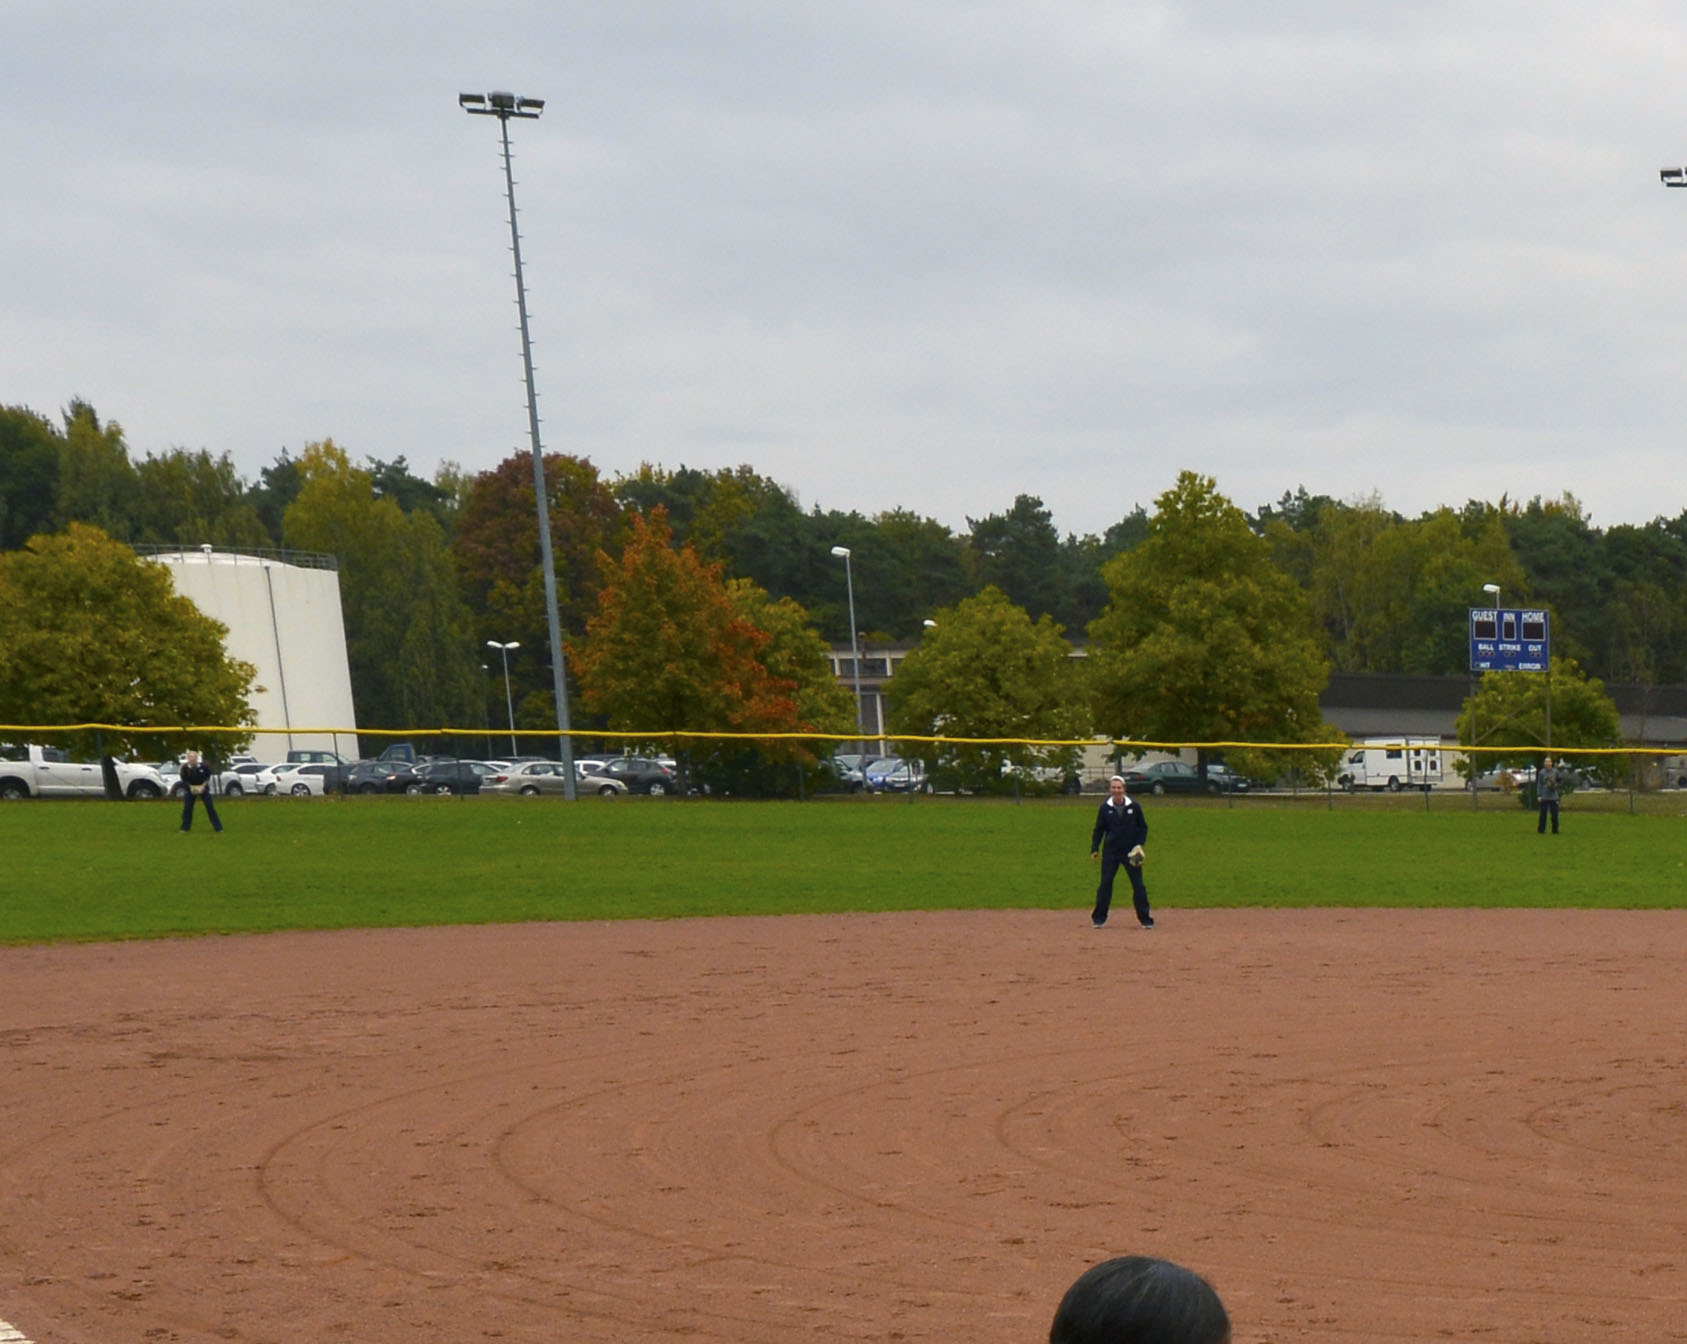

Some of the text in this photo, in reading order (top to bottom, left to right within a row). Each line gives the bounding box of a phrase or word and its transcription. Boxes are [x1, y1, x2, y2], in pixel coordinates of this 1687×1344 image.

[1472, 610, 1544, 622] GUEST INN HOME
[1478, 643, 1541, 652] BALL STRIKE OUT
